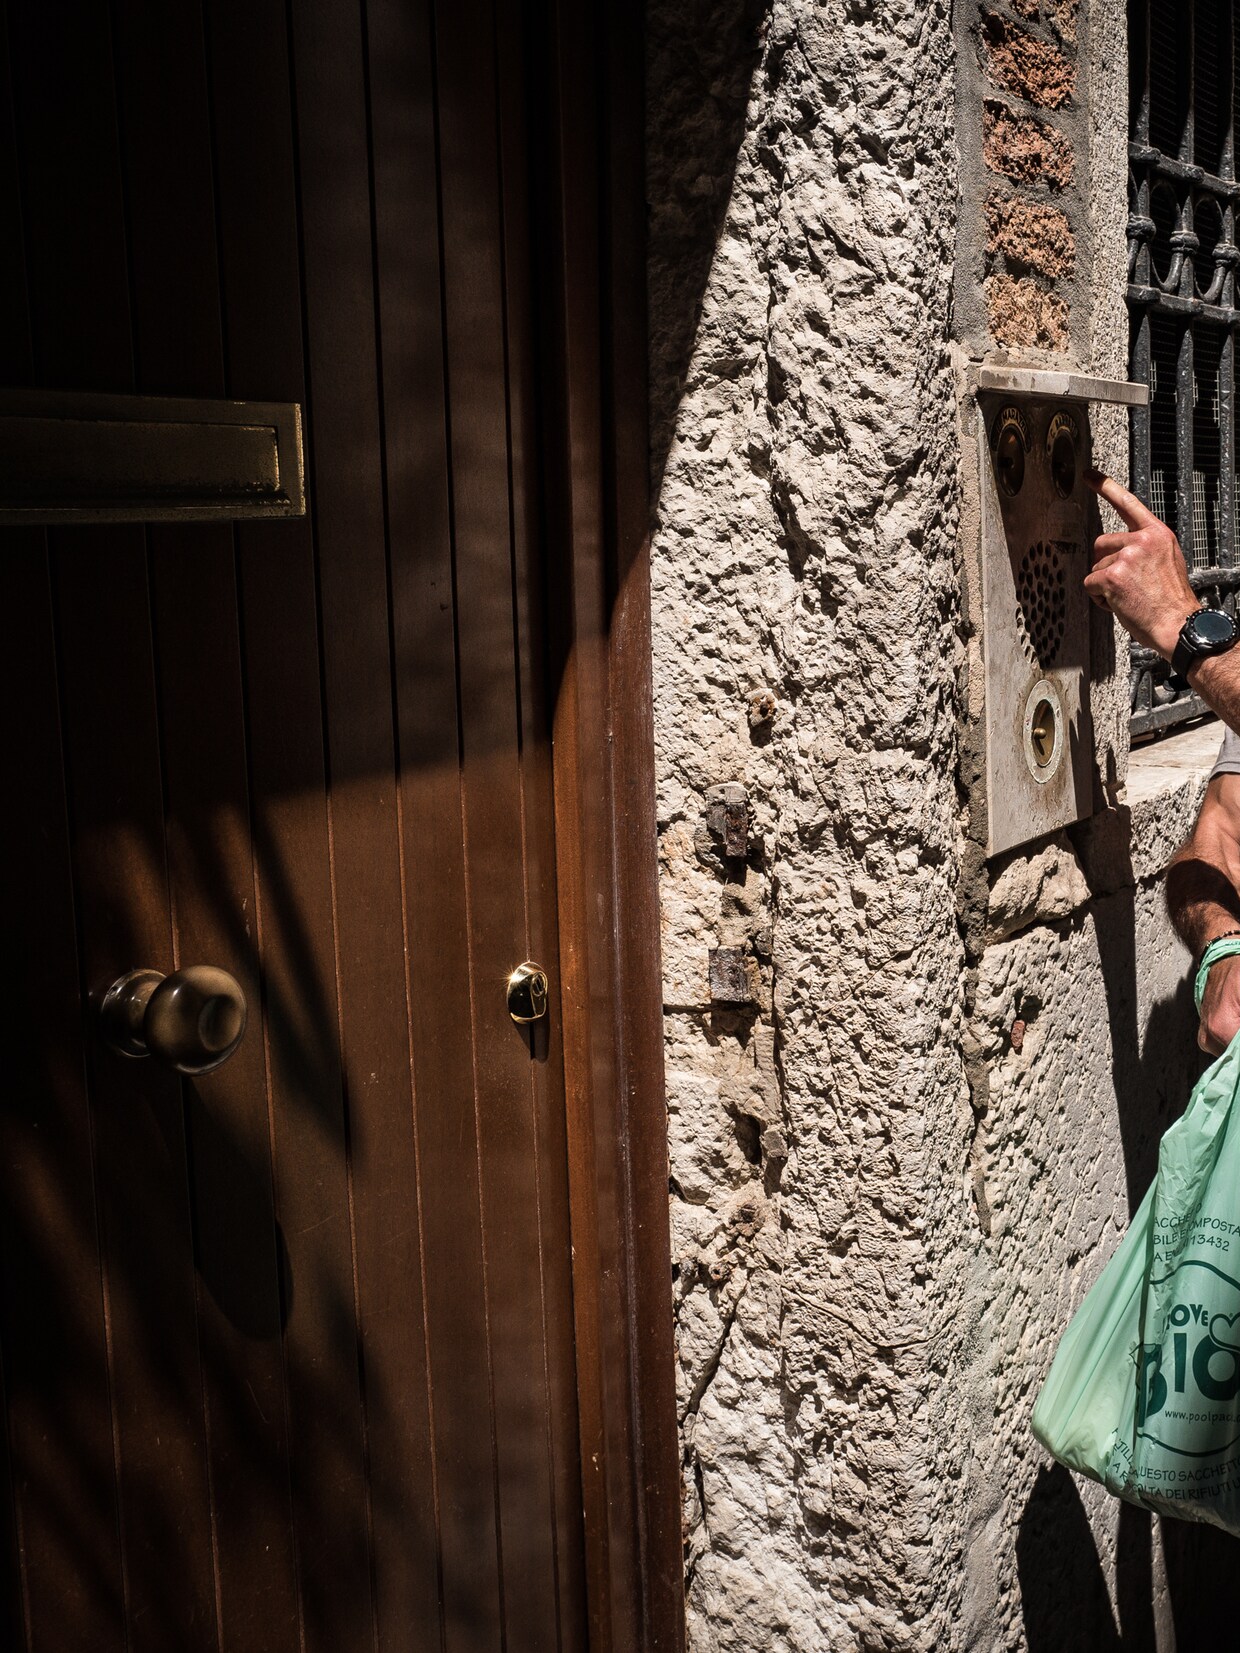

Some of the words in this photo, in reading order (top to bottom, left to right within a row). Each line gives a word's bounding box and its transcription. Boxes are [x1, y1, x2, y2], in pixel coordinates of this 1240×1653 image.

[1190, 1234, 1230, 1252] 13432
[1140, 1466, 1176, 1482] UESTO
[1165, 1488, 1186, 1500] DEI
[1187, 1480, 1232, 1500] RIFIUTI
